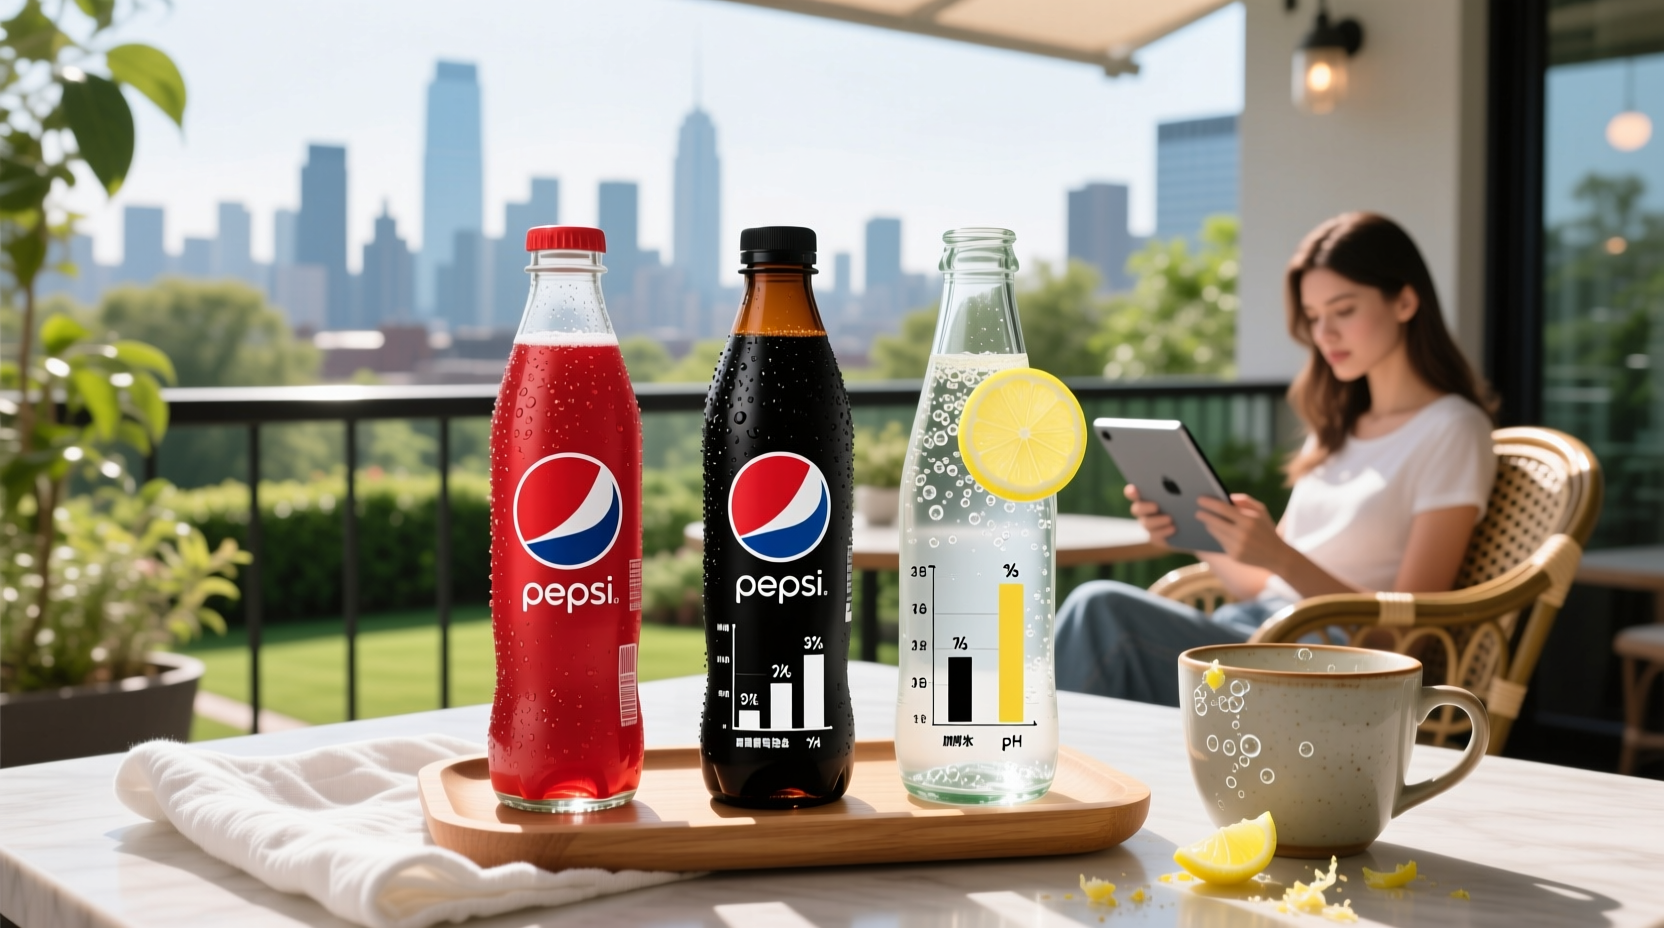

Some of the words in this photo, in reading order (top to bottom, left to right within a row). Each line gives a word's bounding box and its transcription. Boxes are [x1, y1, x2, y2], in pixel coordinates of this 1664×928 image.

[522, 575, 613, 614] pepsi
[735, 569, 823, 605] pepsi
[1002, 734, 1022, 752] pH
